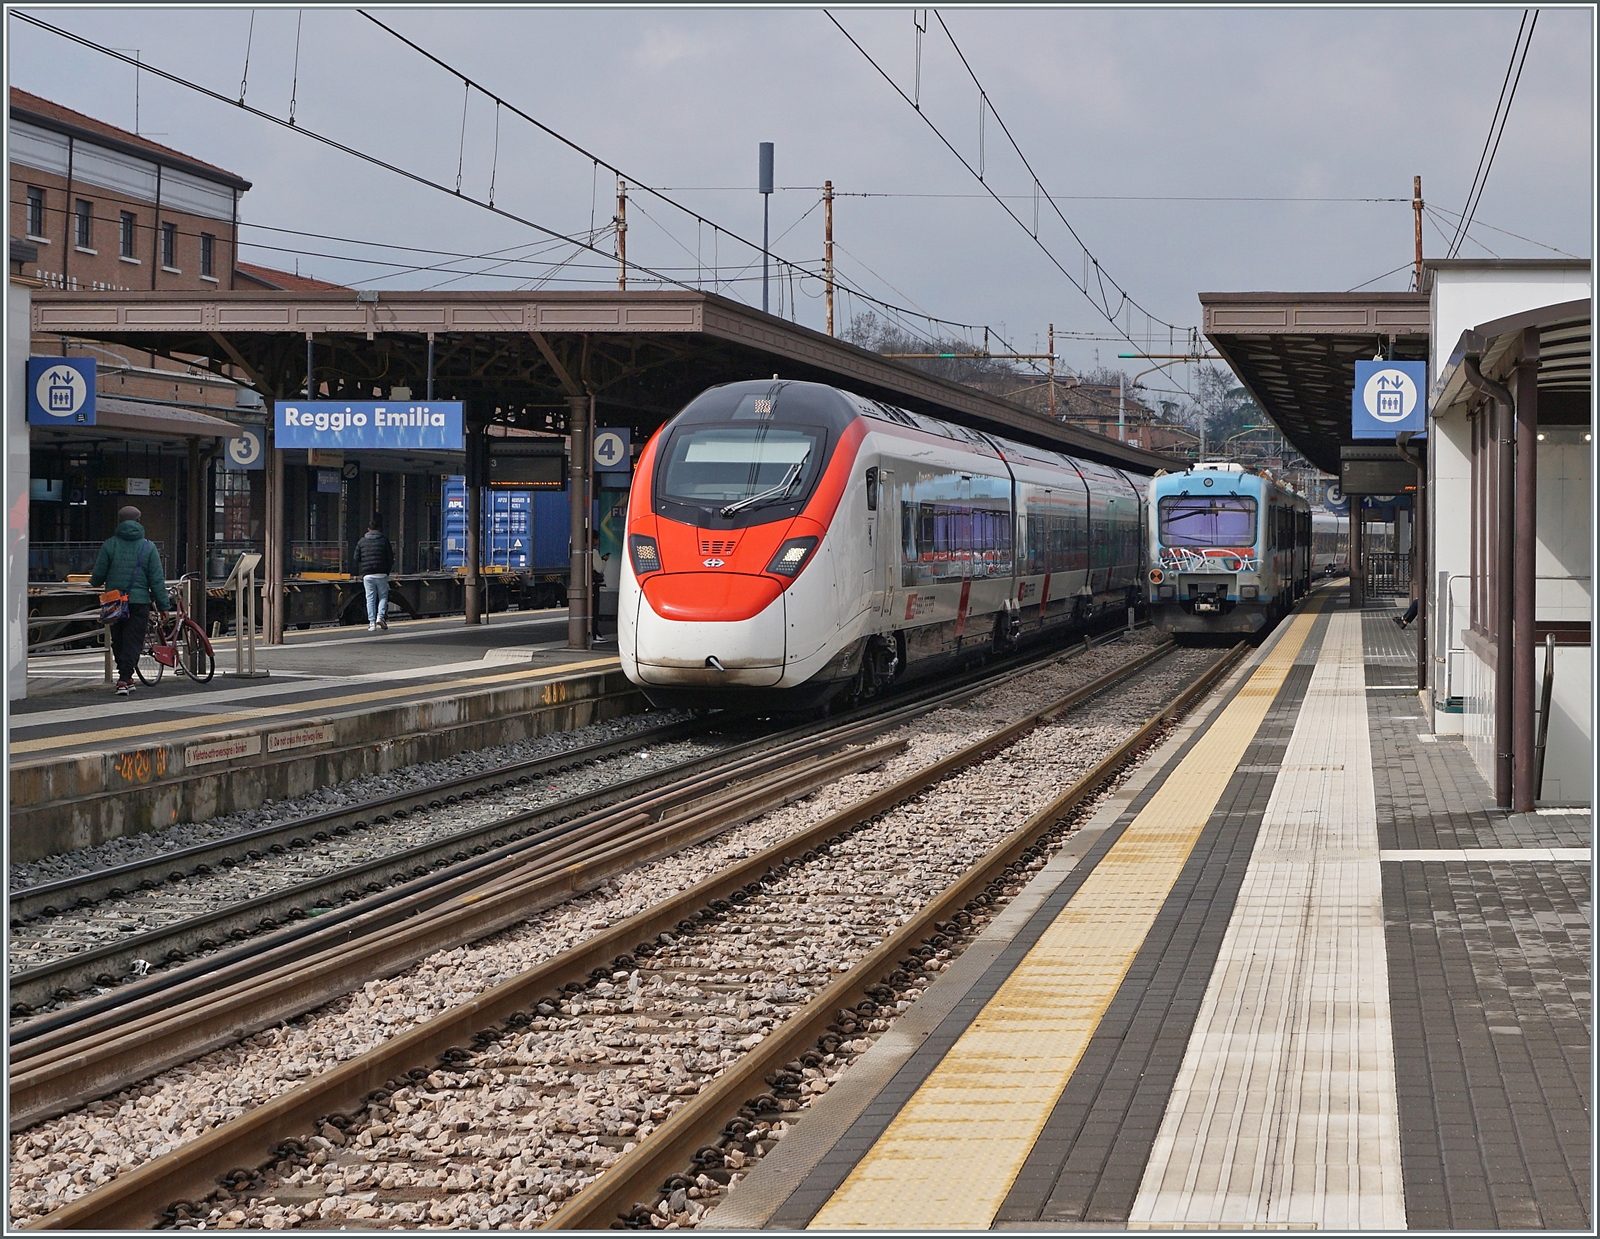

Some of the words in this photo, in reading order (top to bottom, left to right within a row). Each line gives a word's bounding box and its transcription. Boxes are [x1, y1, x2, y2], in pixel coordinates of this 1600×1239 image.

[285, 407, 367, 431] Reggio
[375, 406, 445, 427] Emilia
[237, 437, 252, 458] 3
[598, 439, 616, 460] 4
[490, 459, 497, 467] 3
[1343, 463, 1350, 471] 5
[274, 736, 279, 747] Do
